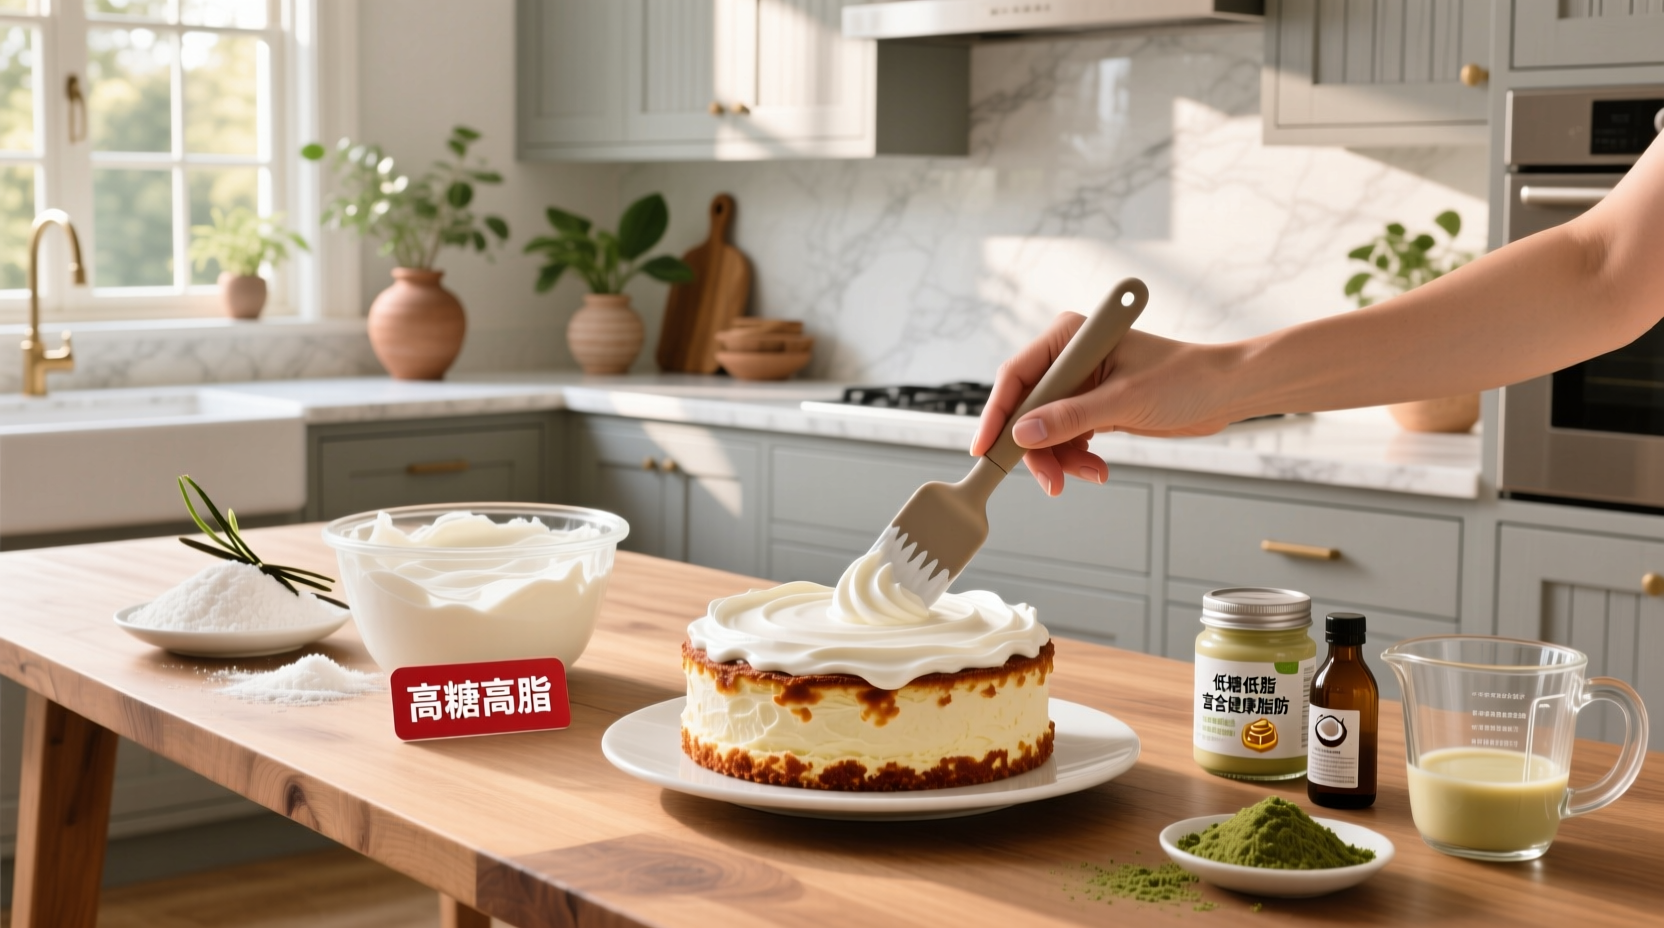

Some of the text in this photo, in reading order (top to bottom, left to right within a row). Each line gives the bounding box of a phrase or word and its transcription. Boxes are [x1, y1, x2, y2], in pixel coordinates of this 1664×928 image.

[406, 675, 552, 723] 高糖高脂
[1212, 673, 1277, 694] 低糖低脂
